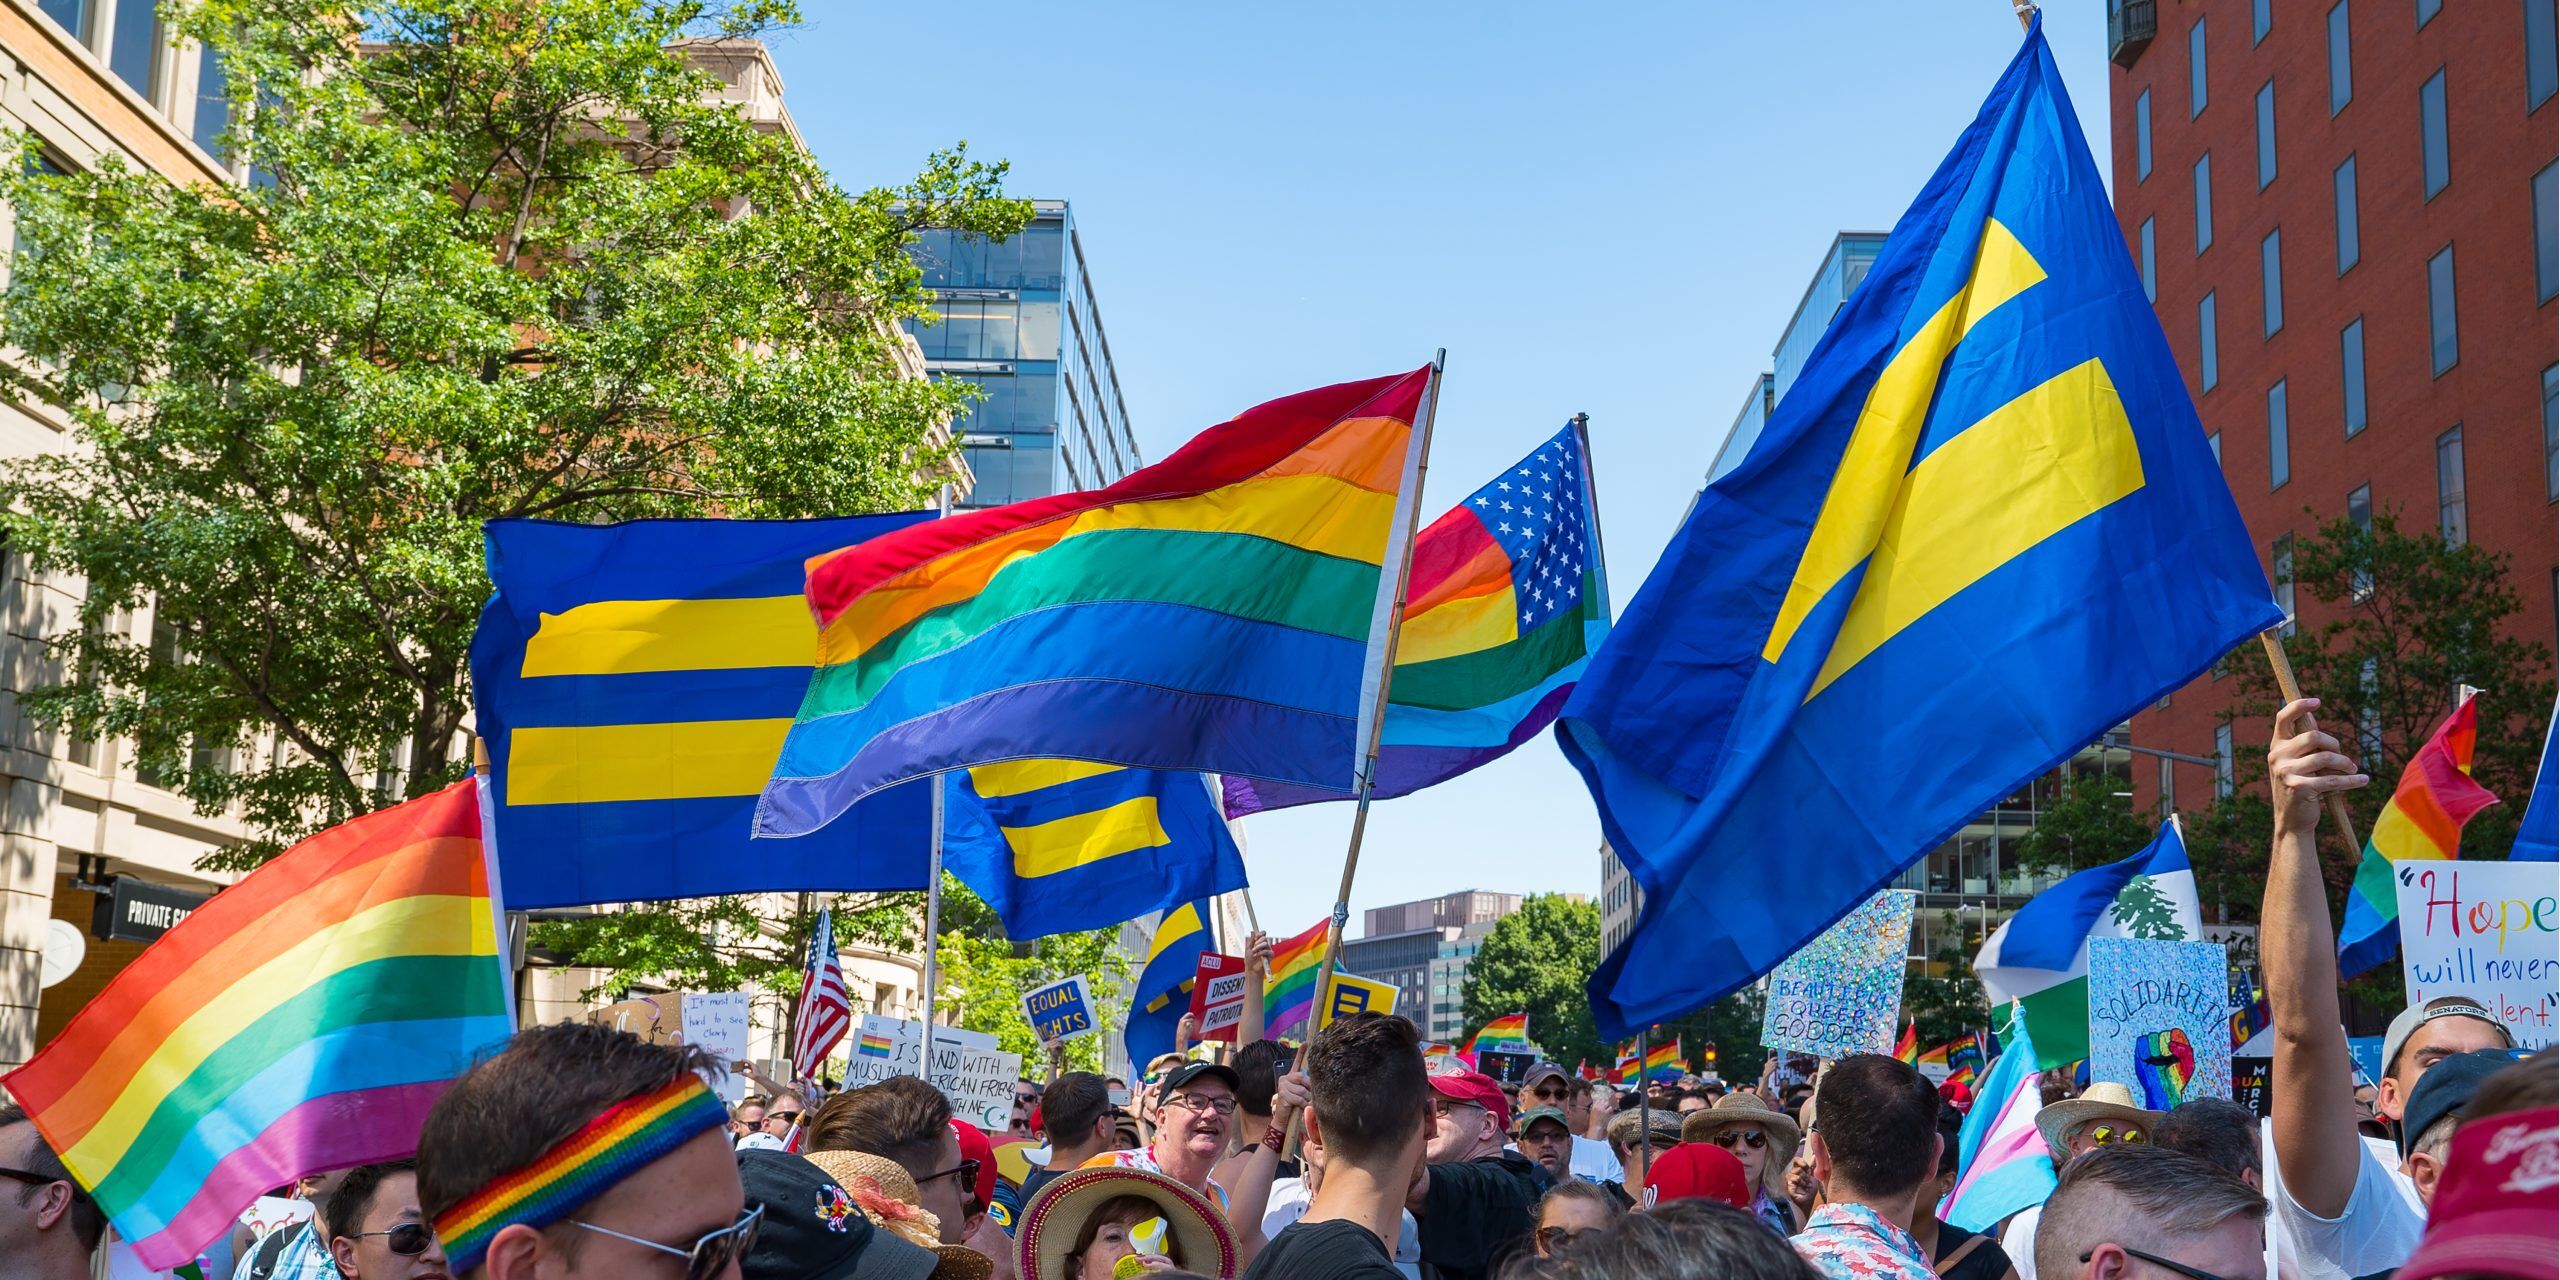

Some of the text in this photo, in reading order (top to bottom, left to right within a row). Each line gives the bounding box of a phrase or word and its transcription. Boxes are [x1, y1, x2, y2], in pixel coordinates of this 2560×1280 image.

[127, 900, 193, 928] PRIVATE GA
[2413, 947, 2559, 984] will never
[1030, 986, 1078, 1015] EQUAL
[1211, 977, 1246, 998] DISSENT
[1790, 1000, 1866, 1025] QUEER
[2097, 979, 2229, 1038] SOLIDARITY
[2429, 1003, 2487, 1018] SENATORS
[1773, 1013, 1881, 1050] GODDESS
[894, 1042, 908, 1062] I
[908, 1044, 959, 1070] SND
[963, 1055, 1001, 1075] WITH
[846, 1059, 902, 1081] MUSLIM
[911, 1069, 978, 1095] ERICAN
[967, 1100, 987, 1115] ME
